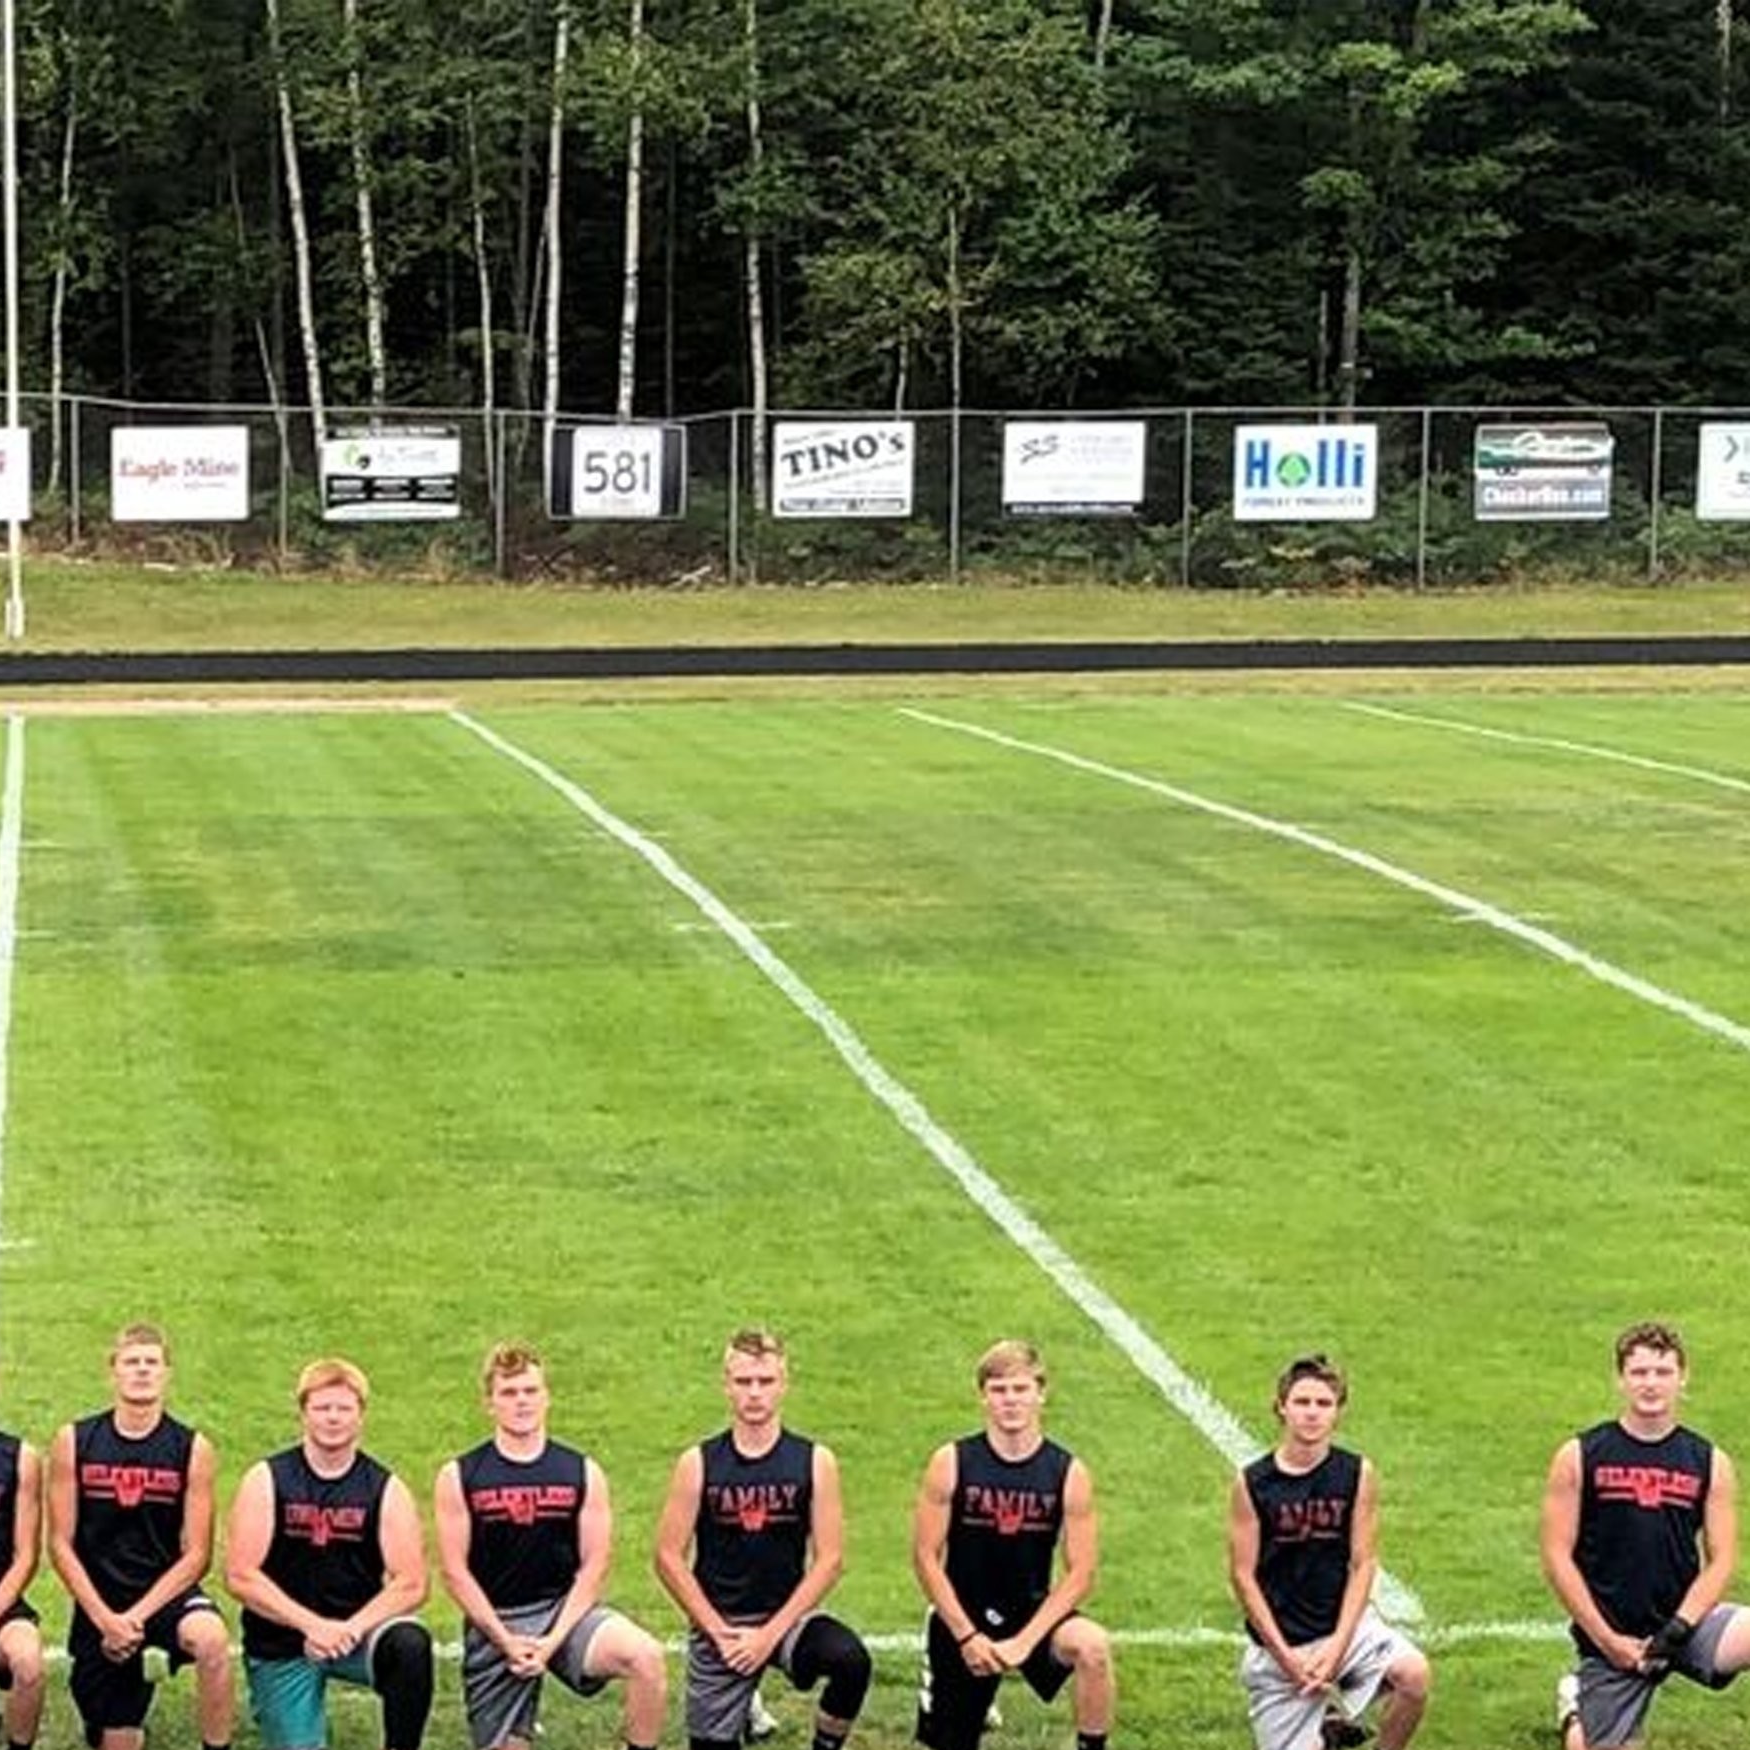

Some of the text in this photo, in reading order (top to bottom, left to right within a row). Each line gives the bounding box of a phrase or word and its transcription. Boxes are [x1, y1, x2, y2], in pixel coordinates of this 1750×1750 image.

[118, 457, 239, 484] Eagle Mine
[583, 450, 651, 494] 581
[1245, 439, 1365, 489] Holli
[706, 1483, 798, 1512] FAMILY
[964, 1487, 1057, 1516] FAMILY
